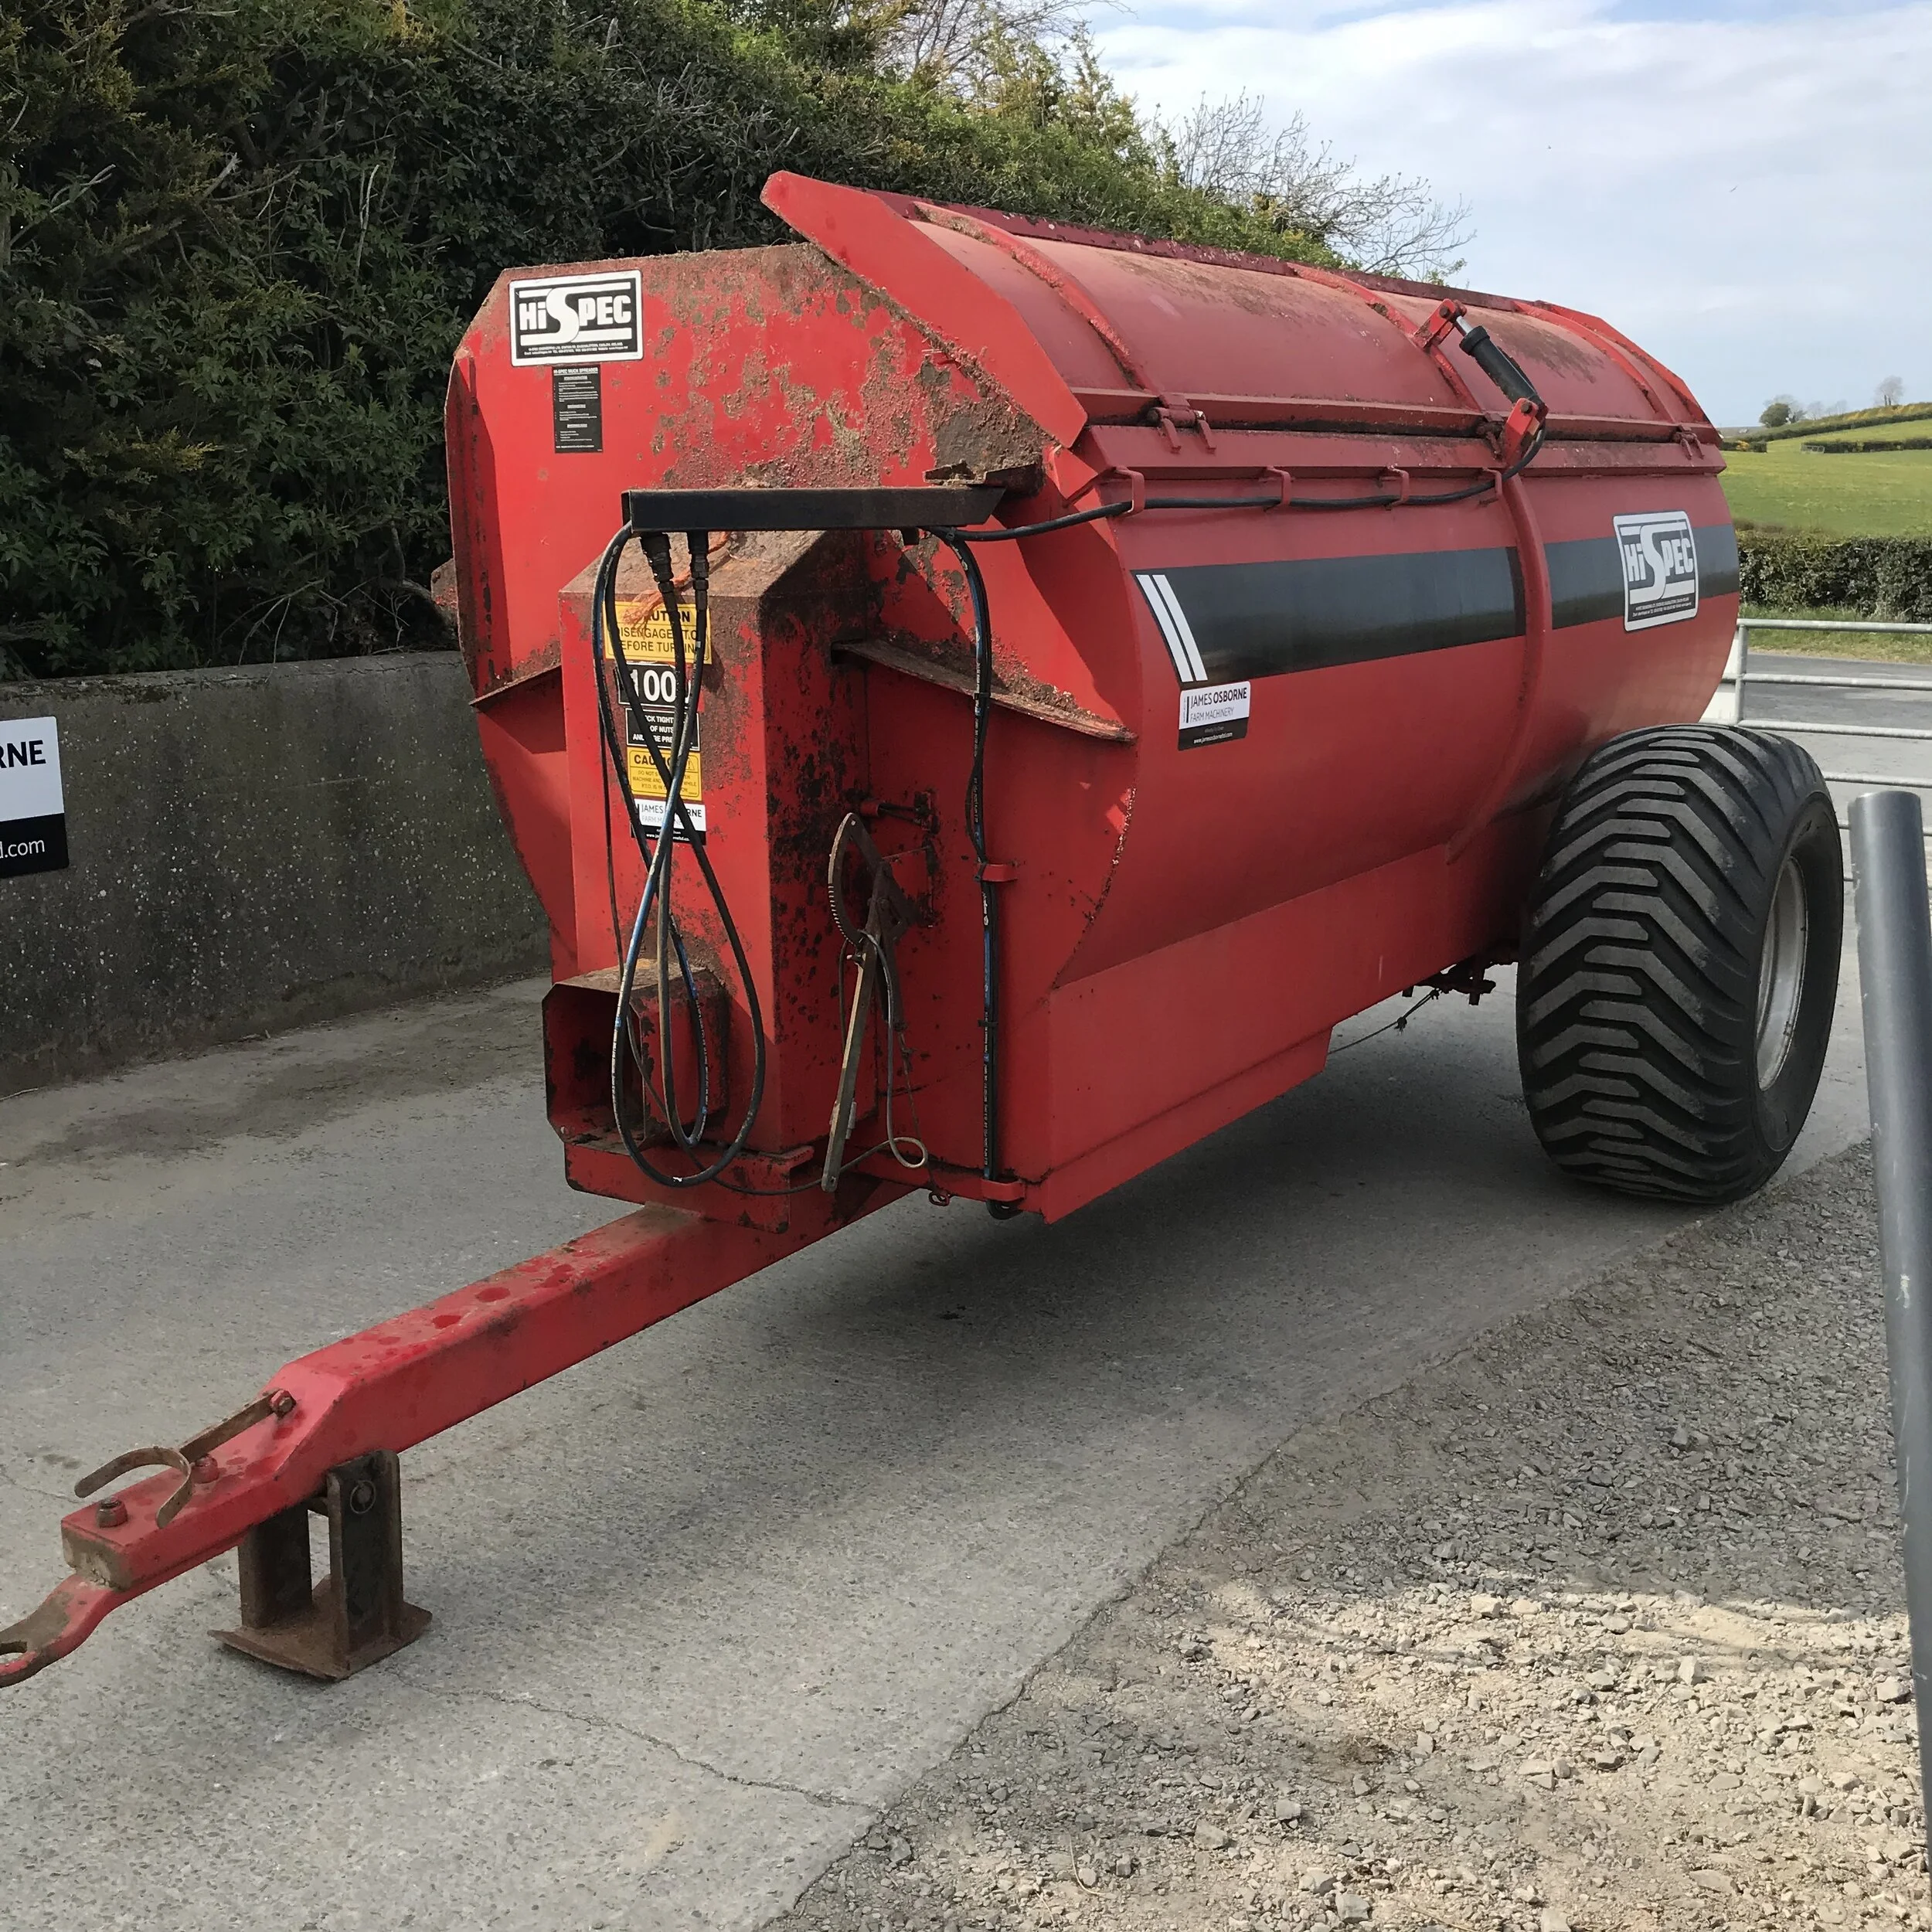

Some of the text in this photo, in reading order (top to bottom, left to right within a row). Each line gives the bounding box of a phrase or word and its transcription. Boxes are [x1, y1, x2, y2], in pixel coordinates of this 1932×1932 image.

[621, 627, 672, 639] ISENGAGE
[621, 640, 654, 651] EFORE
[1191, 687, 1247, 709] JAMES OSBORNE
[1206, 707, 1234, 720] MACHINERY
[641, 804, 664, 814] JAMES
